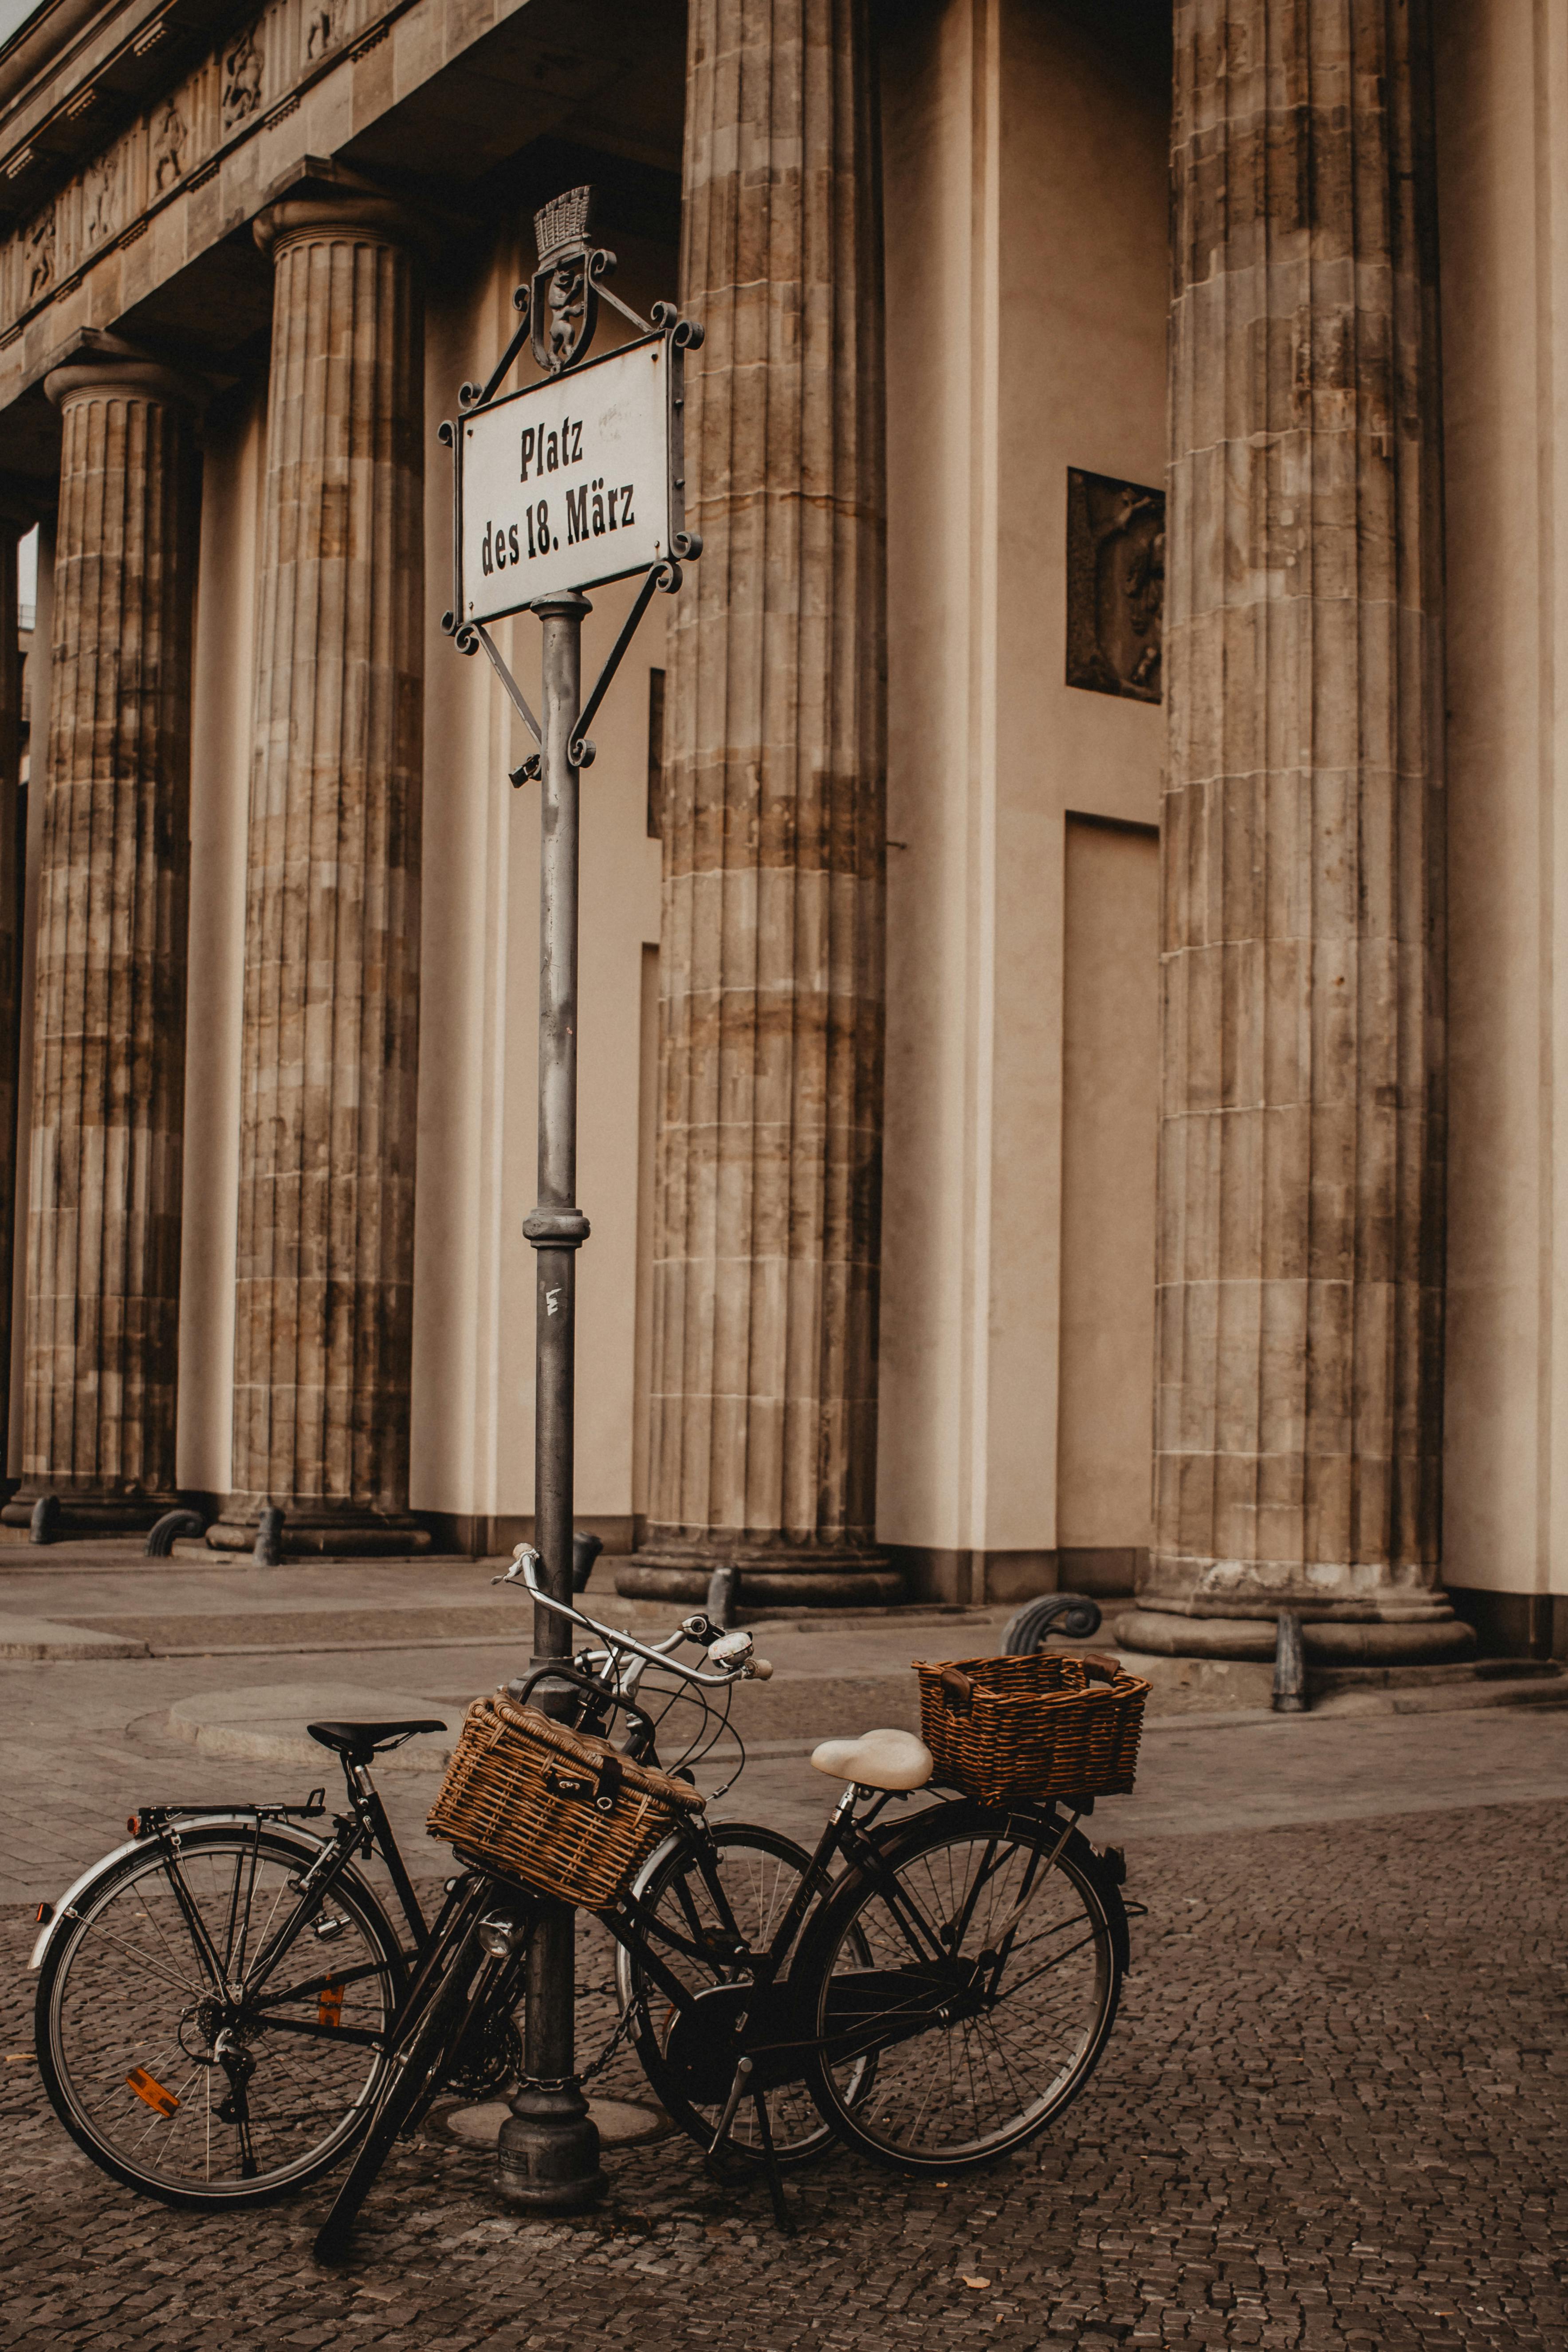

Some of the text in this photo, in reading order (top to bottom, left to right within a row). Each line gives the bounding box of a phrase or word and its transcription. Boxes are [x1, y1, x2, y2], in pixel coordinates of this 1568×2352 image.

[520, 416, 583, 483] Platz
[482, 477, 635, 577] des 18. März
